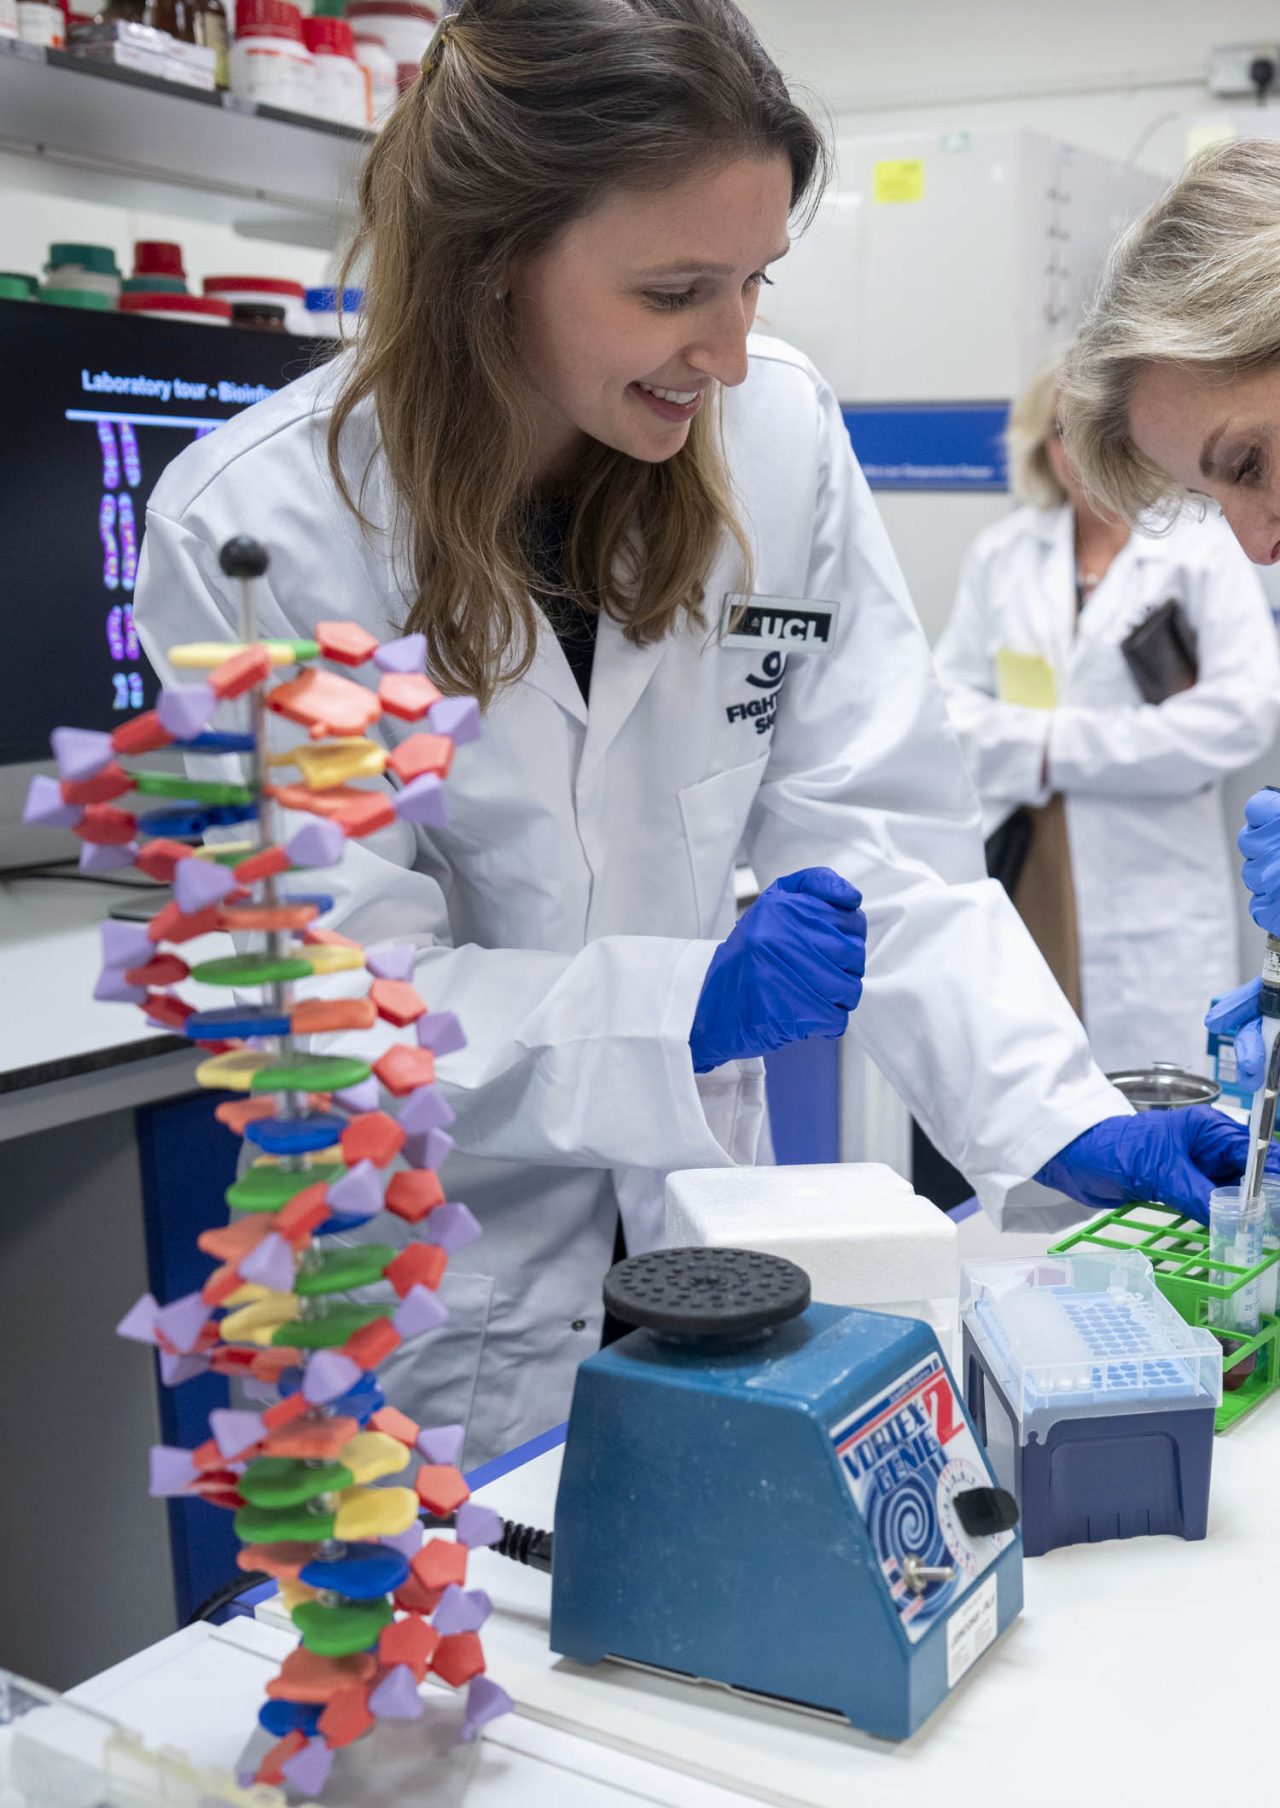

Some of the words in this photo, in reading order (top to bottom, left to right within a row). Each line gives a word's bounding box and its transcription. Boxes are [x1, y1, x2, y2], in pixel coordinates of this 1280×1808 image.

[81, 367, 172, 402] Laboratory
[173, 377, 208, 400] tour
[760, 616, 824, 641] UCL
[873, 1424, 942, 1497] GENIE
[921, 1376, 966, 1447] 2
